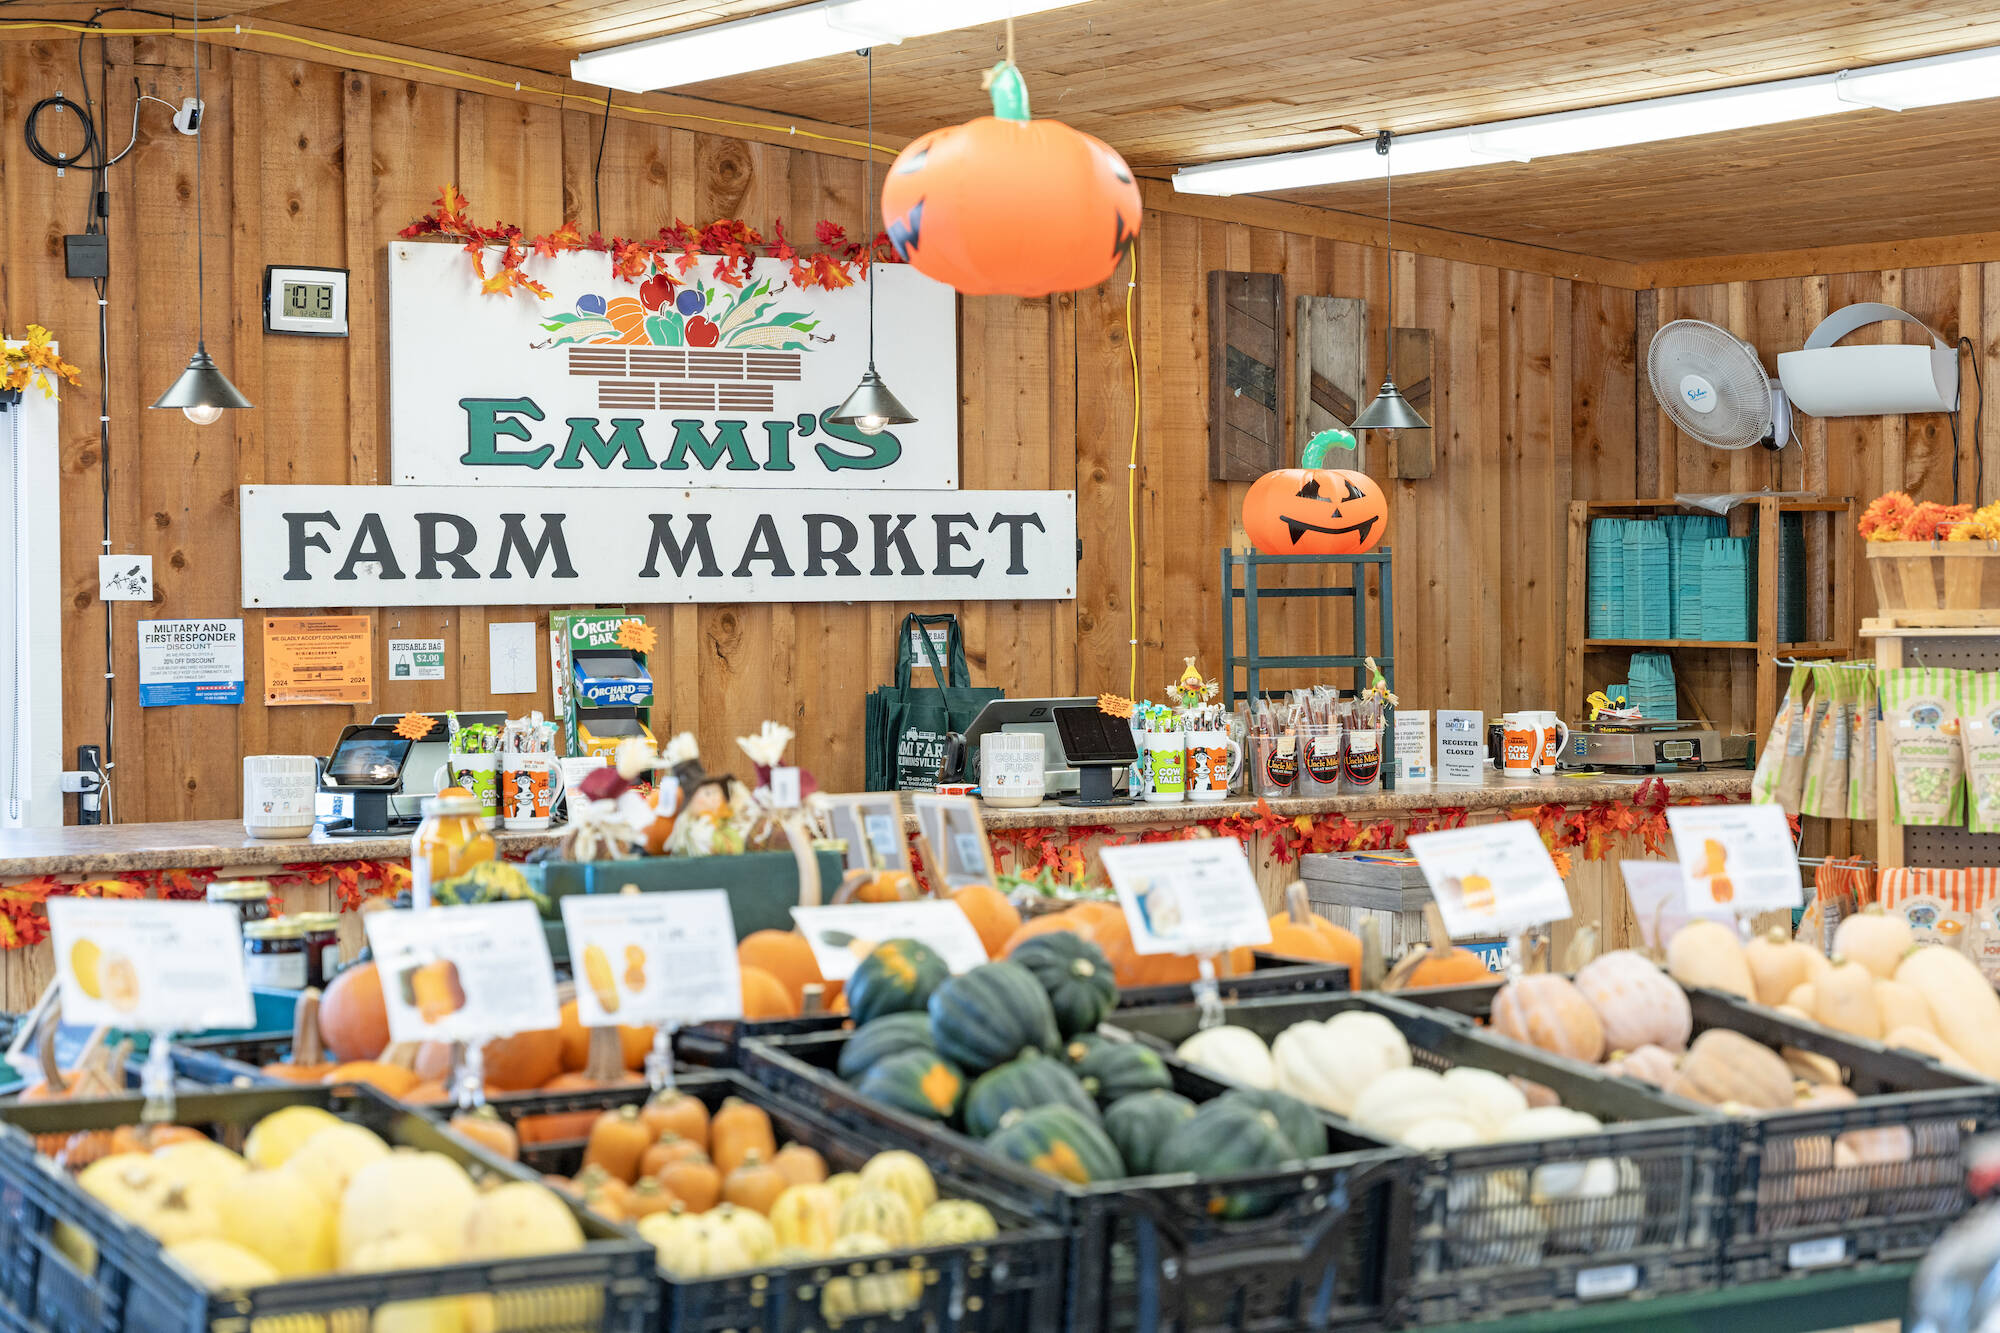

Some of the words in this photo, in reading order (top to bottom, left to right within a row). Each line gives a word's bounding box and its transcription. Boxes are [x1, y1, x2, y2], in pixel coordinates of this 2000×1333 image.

[459, 395, 903, 473] EMMI'S
[282, 511, 579, 580] FARM
[638, 511, 1047, 579] MARKET
[154, 624, 200, 633] MILITARY
[203, 623, 227, 632] AND
[145, 634, 172, 643] FIRST
[174, 633, 236, 642] RESPONDER
[590, 632, 617, 646] BAR
[166, 643, 212, 651] DISCOUNT
[392, 643, 427, 651] REUSABLE
[416, 654, 439, 662] $2.00
[587, 684, 636, 700] ORCHARD
[609, 694, 629, 702] BAR
[915, 742, 945, 757] FAR
[1507, 745, 1528, 753] COW
[1345, 756, 1363, 765] Uncle
[1507, 752, 1529, 760] TALES
[1307, 759, 1325, 768] Uncle
[1159, 768, 1181, 776] COW
[1158, 776, 1181, 784] TALES
